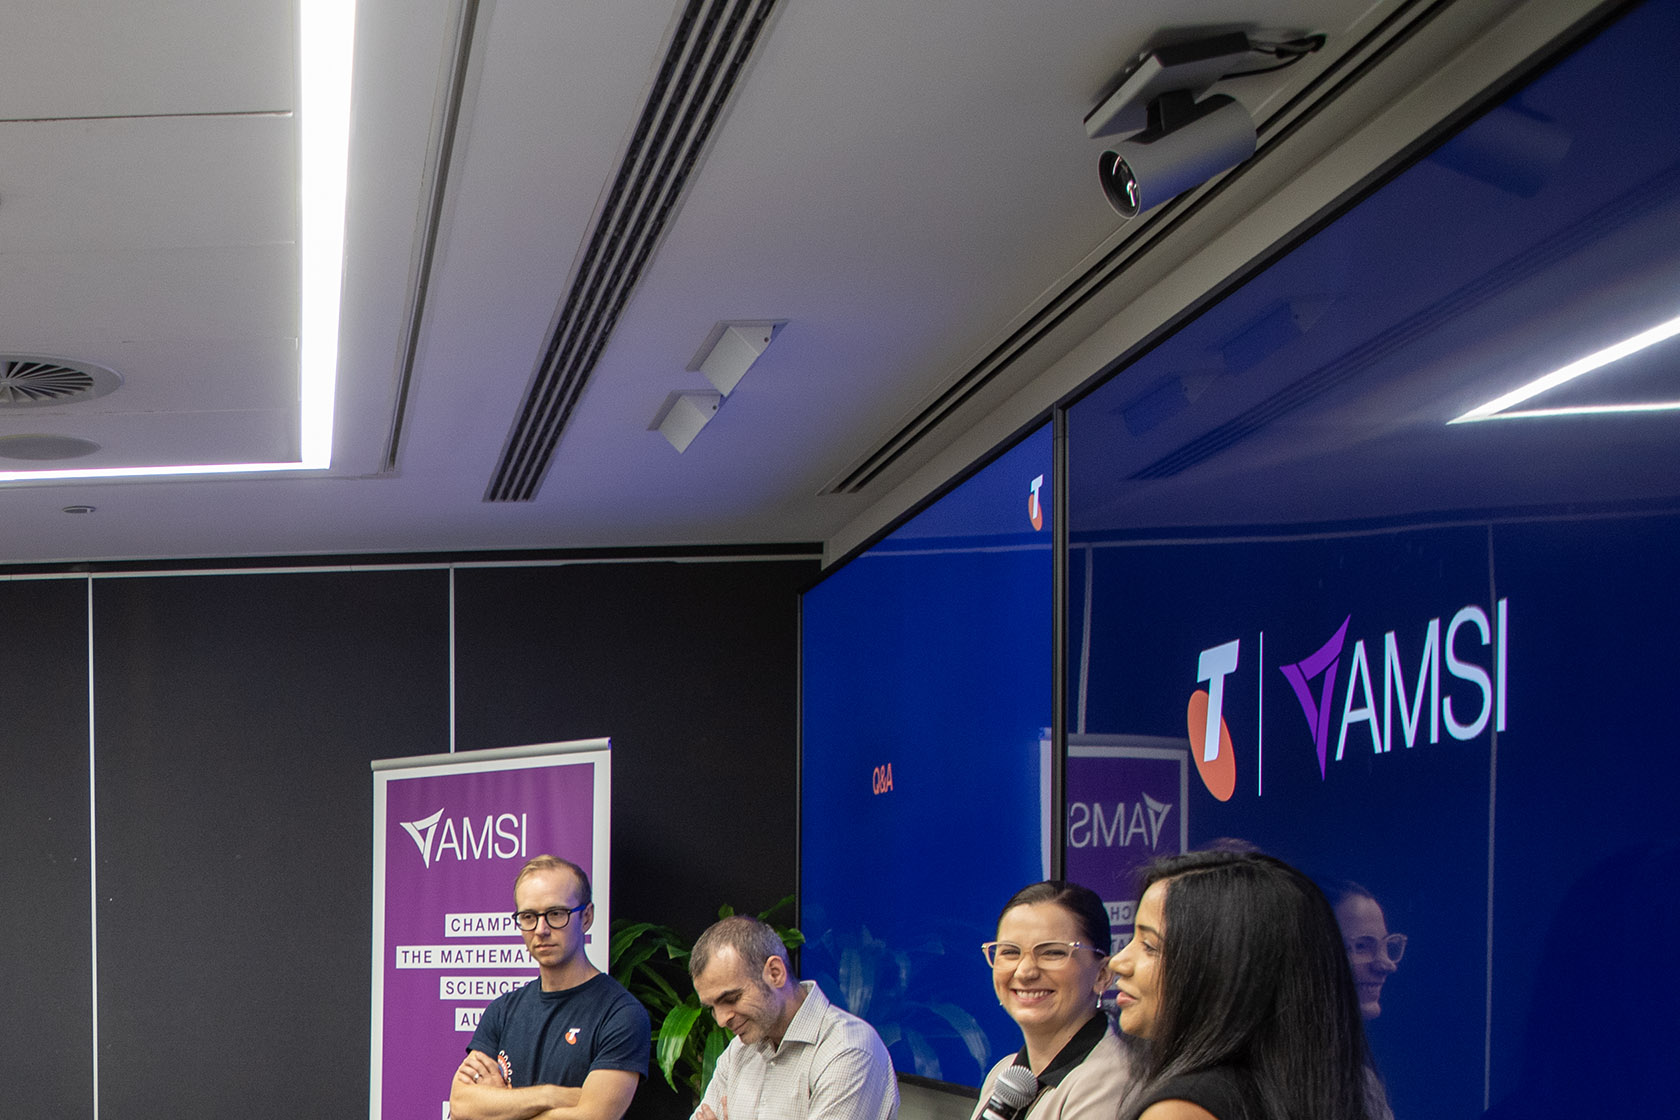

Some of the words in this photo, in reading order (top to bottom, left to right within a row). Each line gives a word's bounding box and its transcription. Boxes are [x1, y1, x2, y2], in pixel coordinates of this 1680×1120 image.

[1335, 597, 1508, 762] AMSI
[872, 762, 894, 795] Q&A
[435, 812, 527, 862] AMSI
[401, 950, 432, 964] THE
